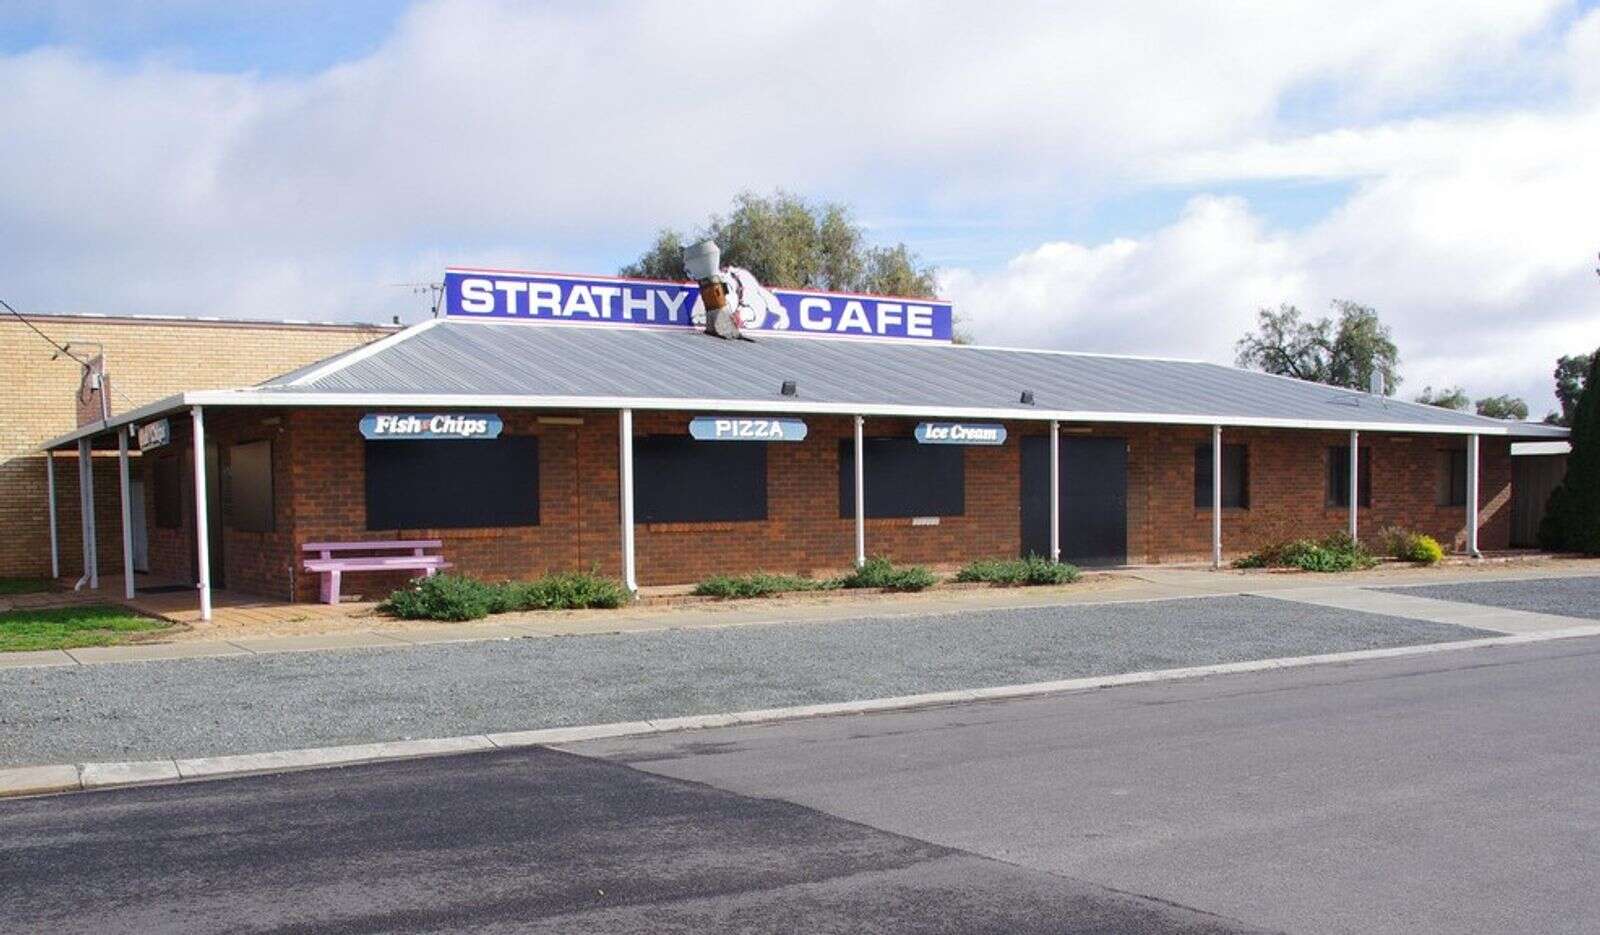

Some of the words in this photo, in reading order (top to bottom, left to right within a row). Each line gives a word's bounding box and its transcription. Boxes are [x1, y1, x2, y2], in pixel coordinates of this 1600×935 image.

[461, 278, 689, 321] STRATHY
[799, 297, 933, 337] CAFE
[374, 415, 420, 433] Fish
[430, 414, 487, 436] Chips
[715, 420, 783, 438] PIZZA
[925, 423, 948, 439] Ice
[951, 424, 997, 440] Cream
